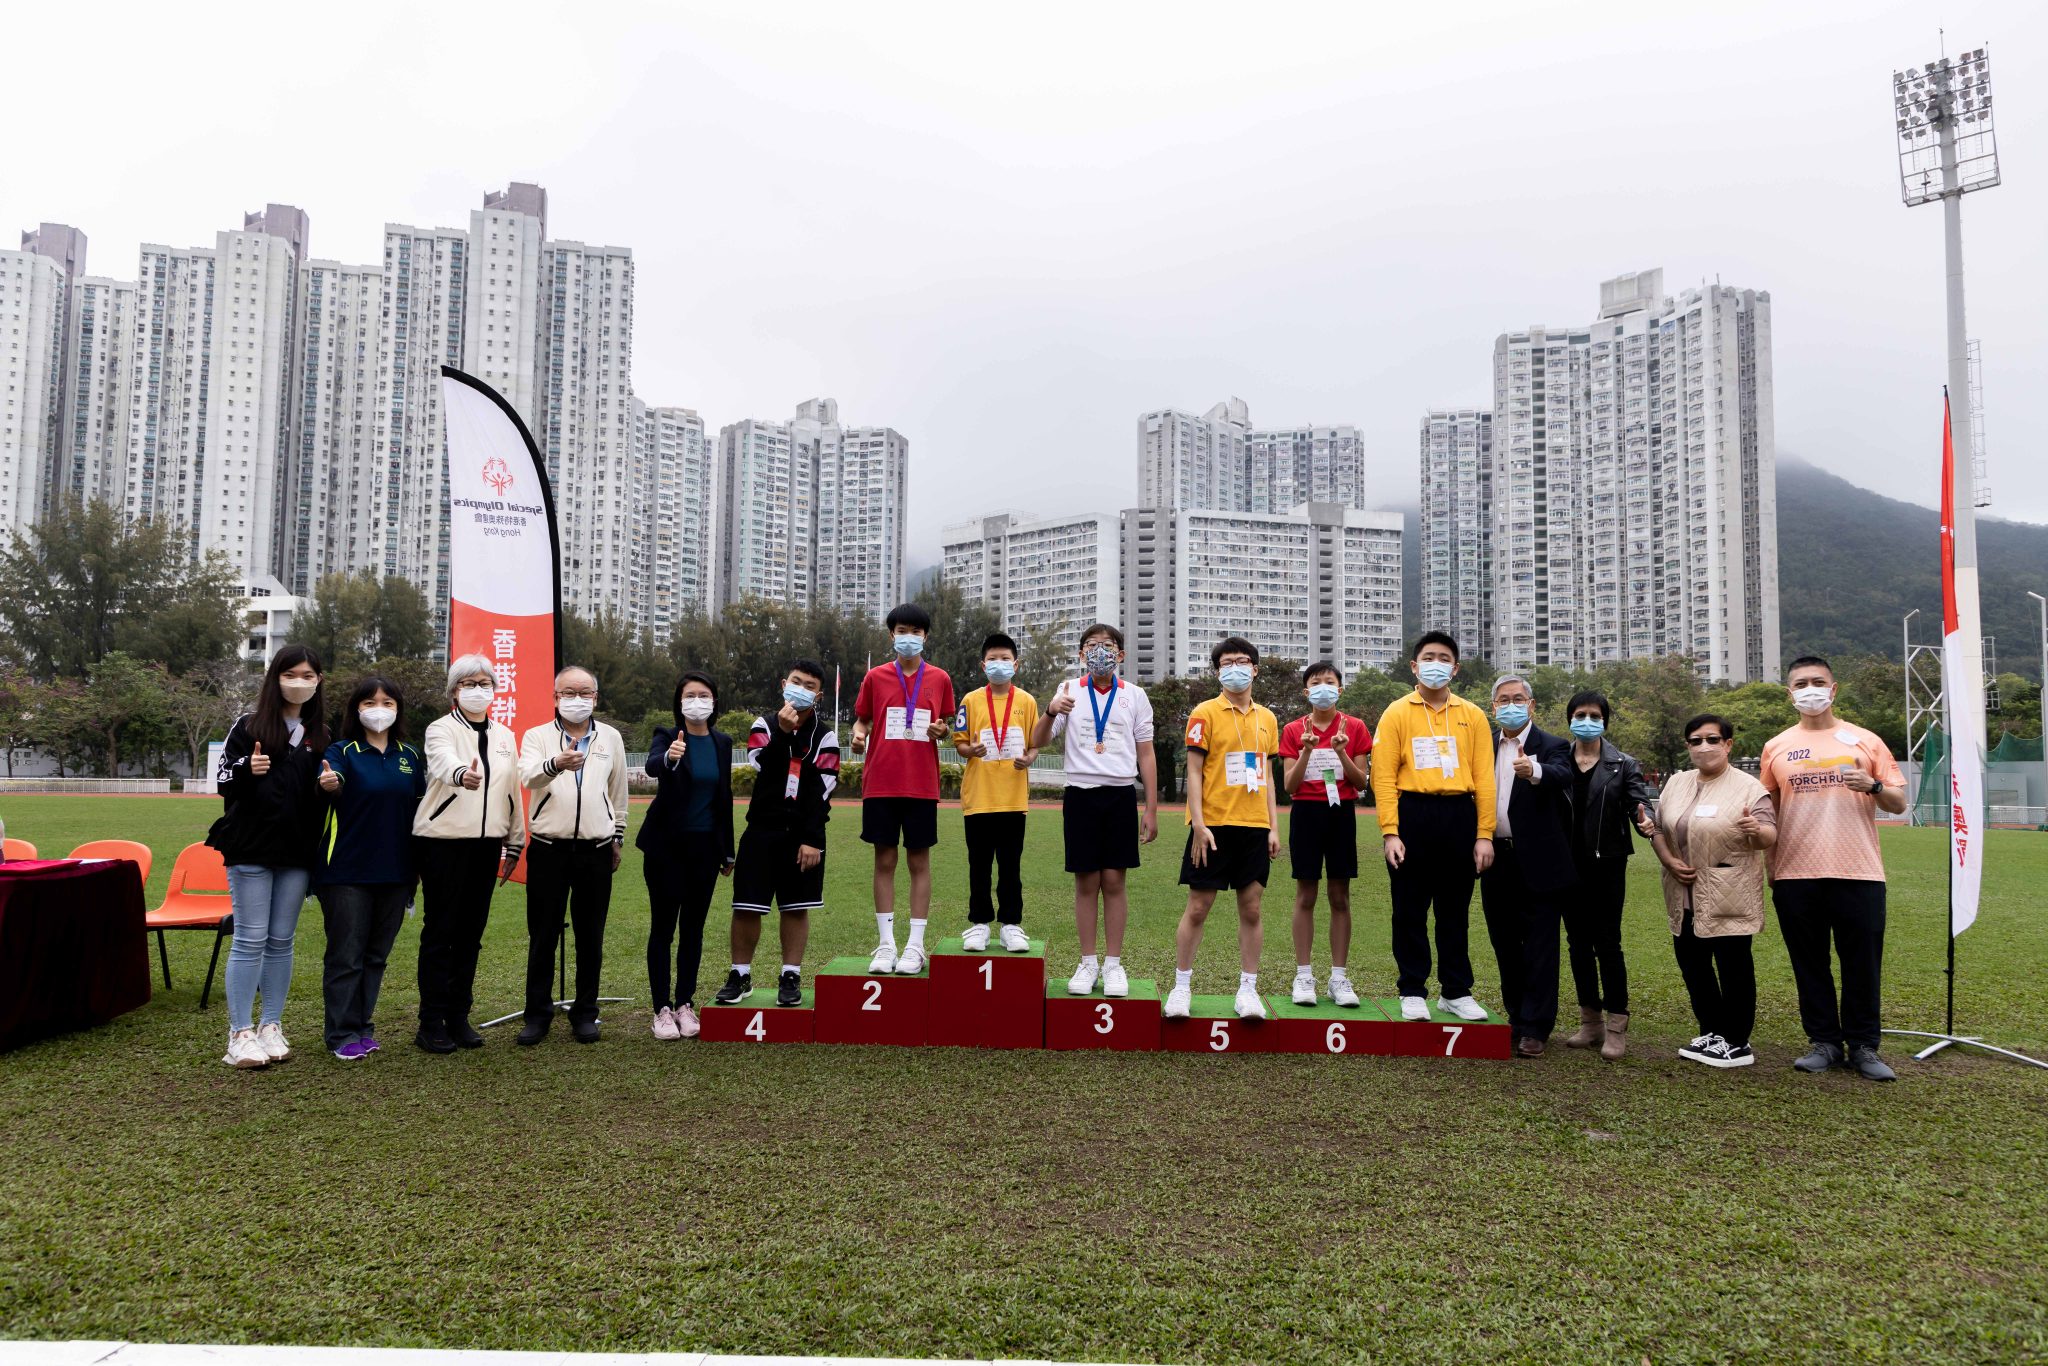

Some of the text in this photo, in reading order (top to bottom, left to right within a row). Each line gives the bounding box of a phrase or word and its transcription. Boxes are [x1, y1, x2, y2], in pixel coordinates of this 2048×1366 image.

[955, 707, 966, 729] 6
[1187, 722, 1203, 744] 4
[1787, 749, 1810, 761] 2022
[1788, 775, 1844, 786] TORCH RU
[978, 960, 993, 991] 1
[861, 980, 882, 1011] 2
[744, 1011, 767, 1042] 4
[1093, 1003, 1114, 1034] 3
[1209, 1020, 1230, 1052] 5
[1325, 1022, 1347, 1054] 6
[1442, 1026, 1463, 1056] 7
